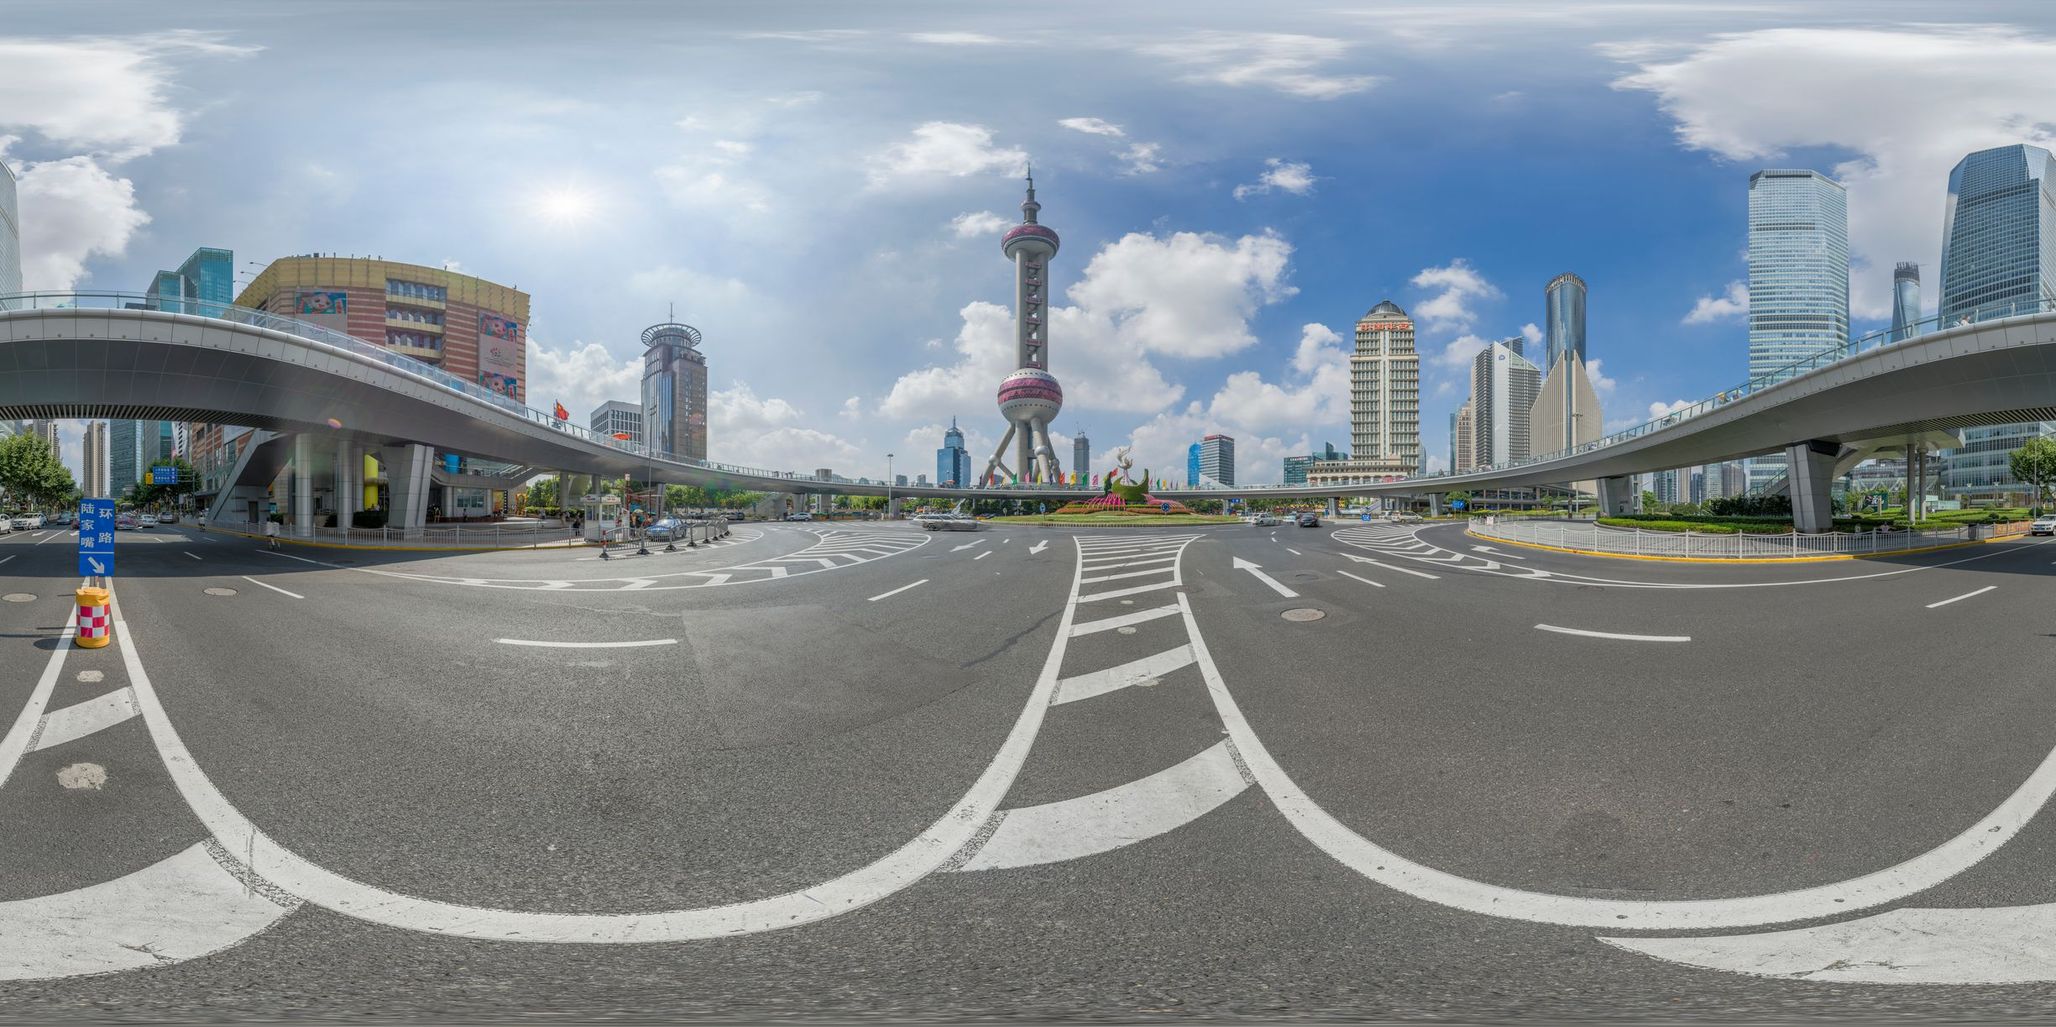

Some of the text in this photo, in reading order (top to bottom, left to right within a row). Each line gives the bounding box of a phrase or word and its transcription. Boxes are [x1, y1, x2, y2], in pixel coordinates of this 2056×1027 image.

[81, 503, 95, 548] 陆家嘴
[98, 508, 113, 544] 环路
